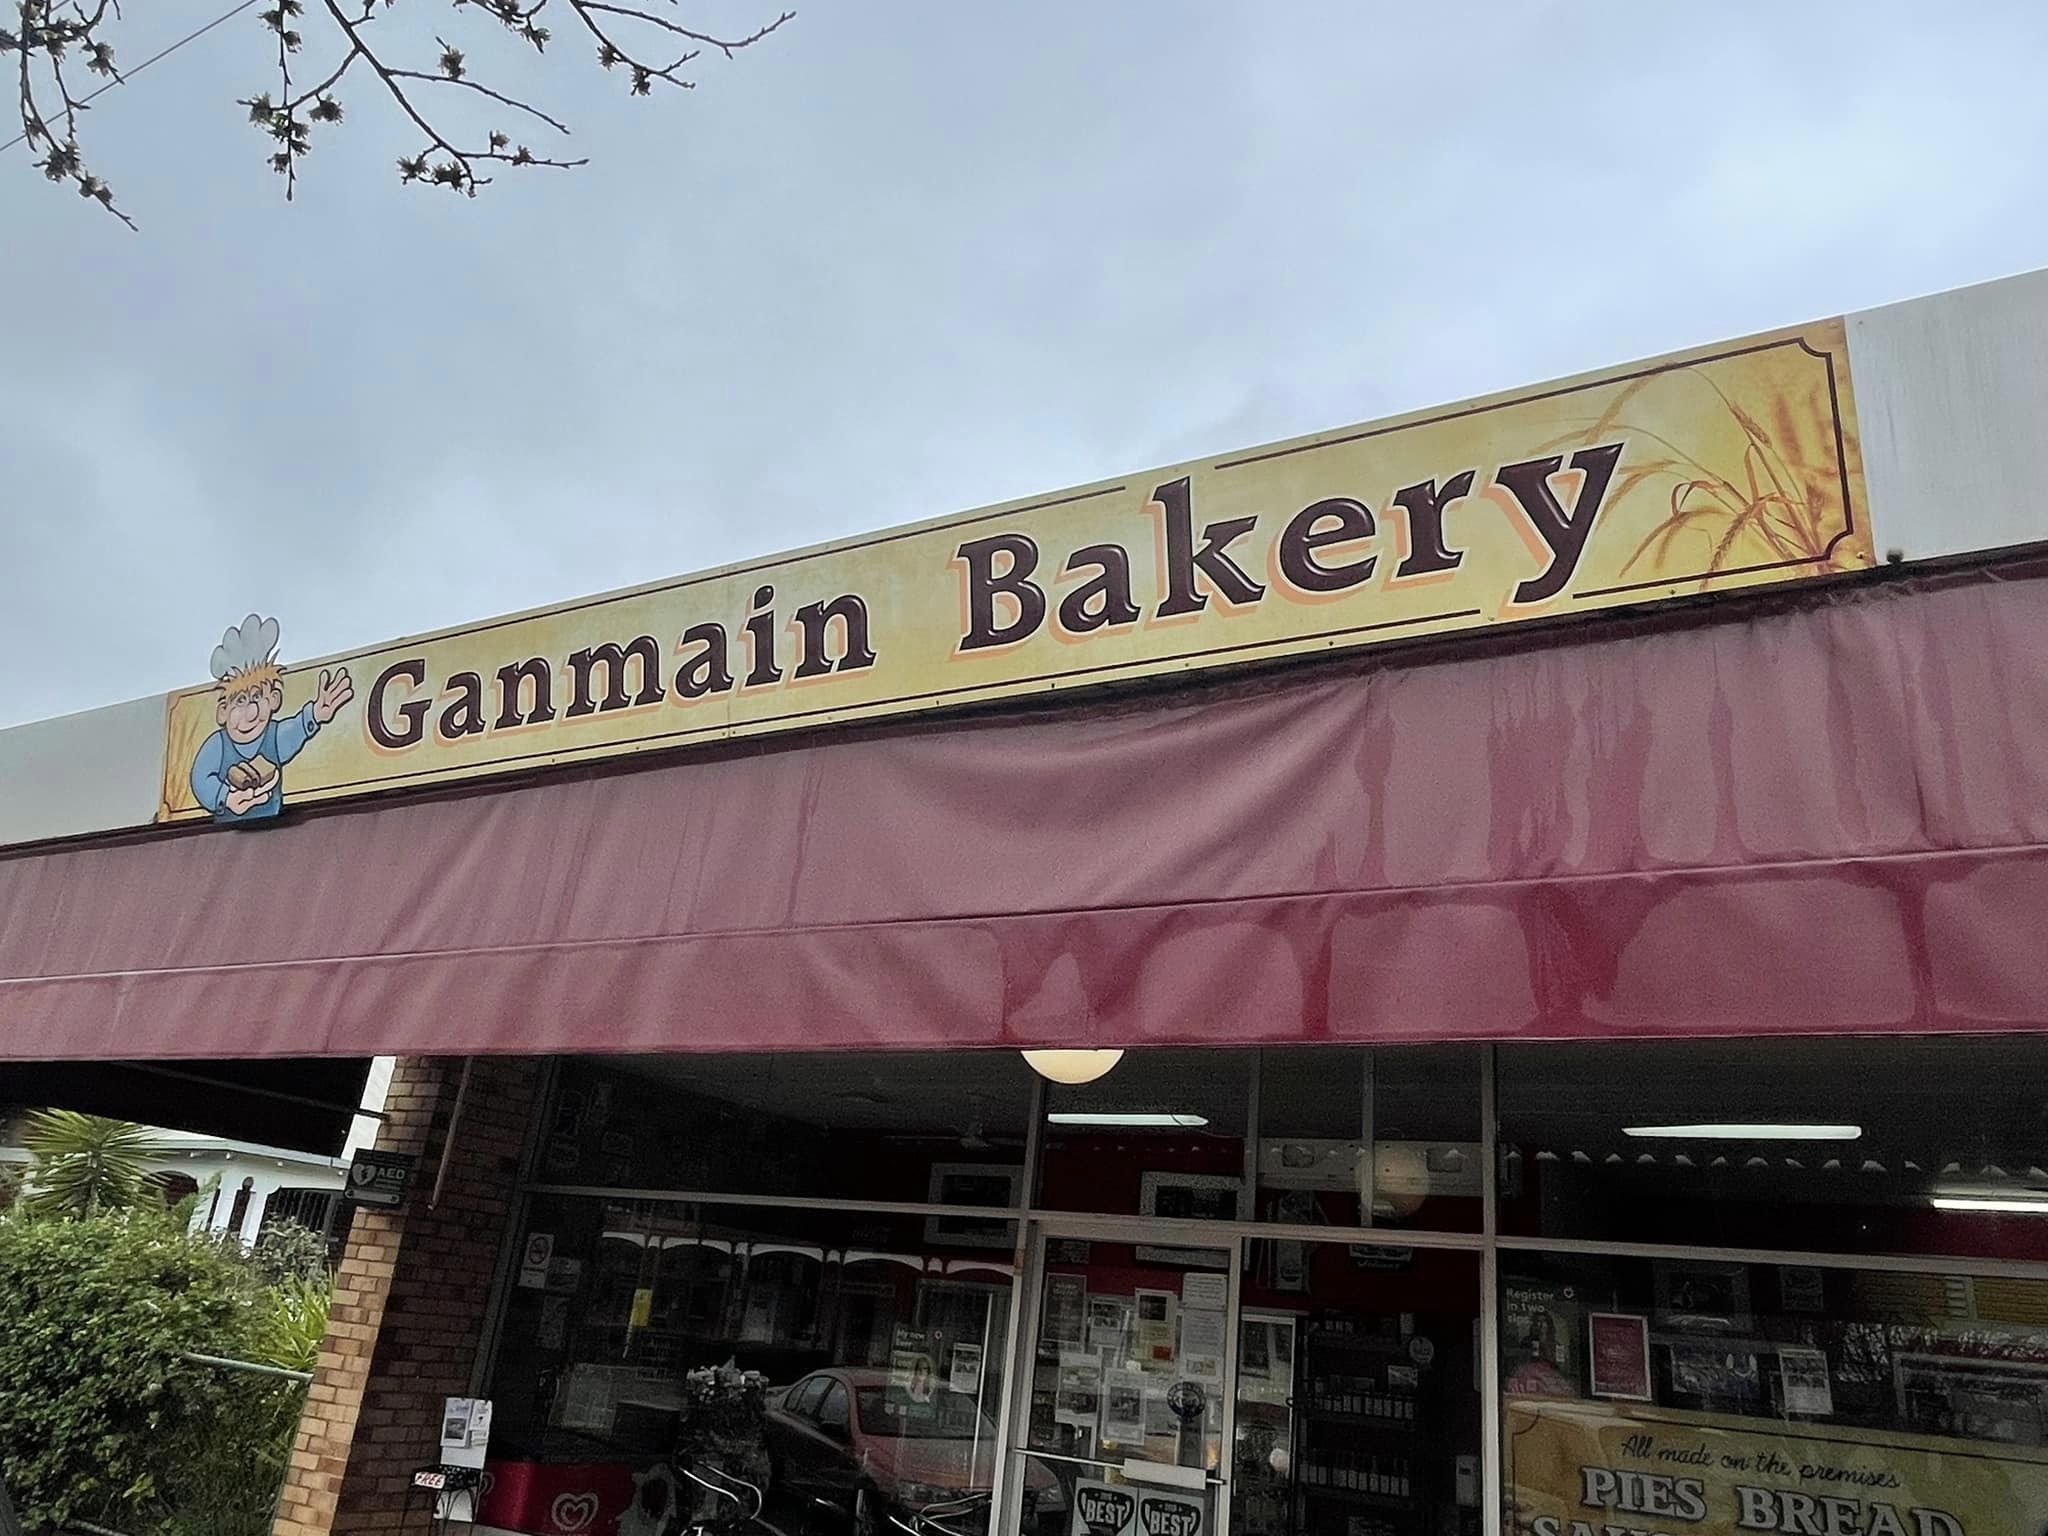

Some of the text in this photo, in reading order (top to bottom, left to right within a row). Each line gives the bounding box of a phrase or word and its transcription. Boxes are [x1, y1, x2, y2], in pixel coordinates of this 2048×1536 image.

[367, 443, 1625, 749] Ganmain Bakery
[377, 1167, 405, 1180] AED
[1506, 1287, 1554, 1301] Register
[1521, 1303, 1545, 1312] two
[1621, 1434, 1900, 1489] All made on the premises
[415, 1470, 443, 1485] FREE
[1085, 1499, 1126, 1528] BEST
[1581, 1466, 1968, 1536] PIES BREAD
[1150, 1510, 1192, 1536] BEST
